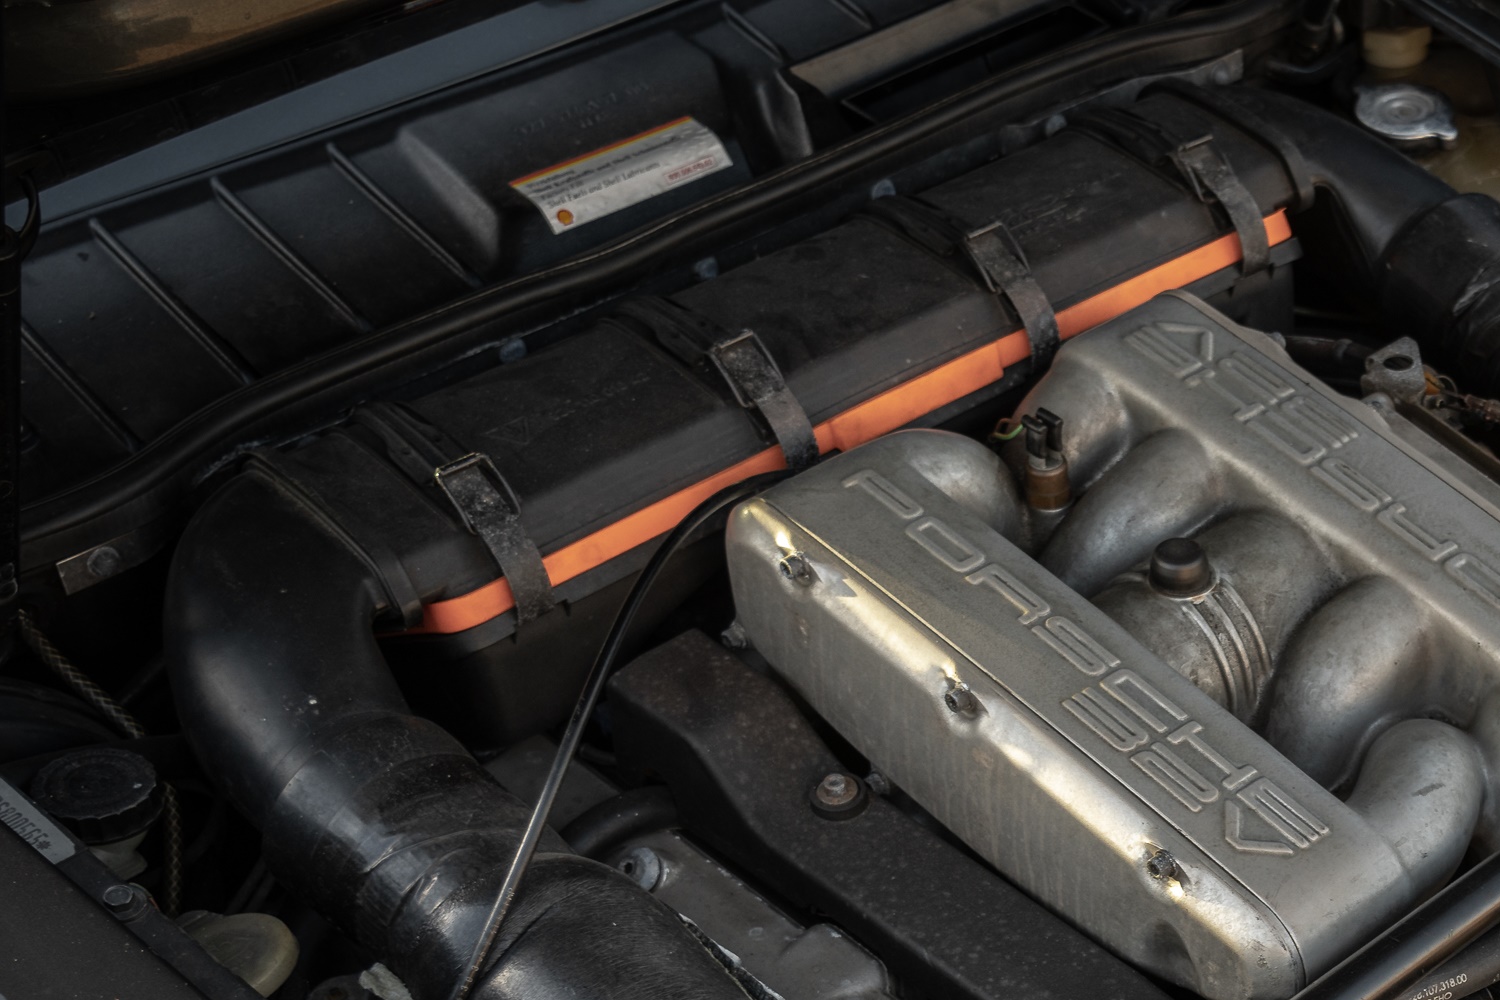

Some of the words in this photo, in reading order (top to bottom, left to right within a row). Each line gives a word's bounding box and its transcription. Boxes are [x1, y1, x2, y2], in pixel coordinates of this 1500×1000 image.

[1155, 322, 1358, 448] 32V
[841, 469, 1330, 849] PORSCHE
[1061, 687, 1294, 855] 32V
